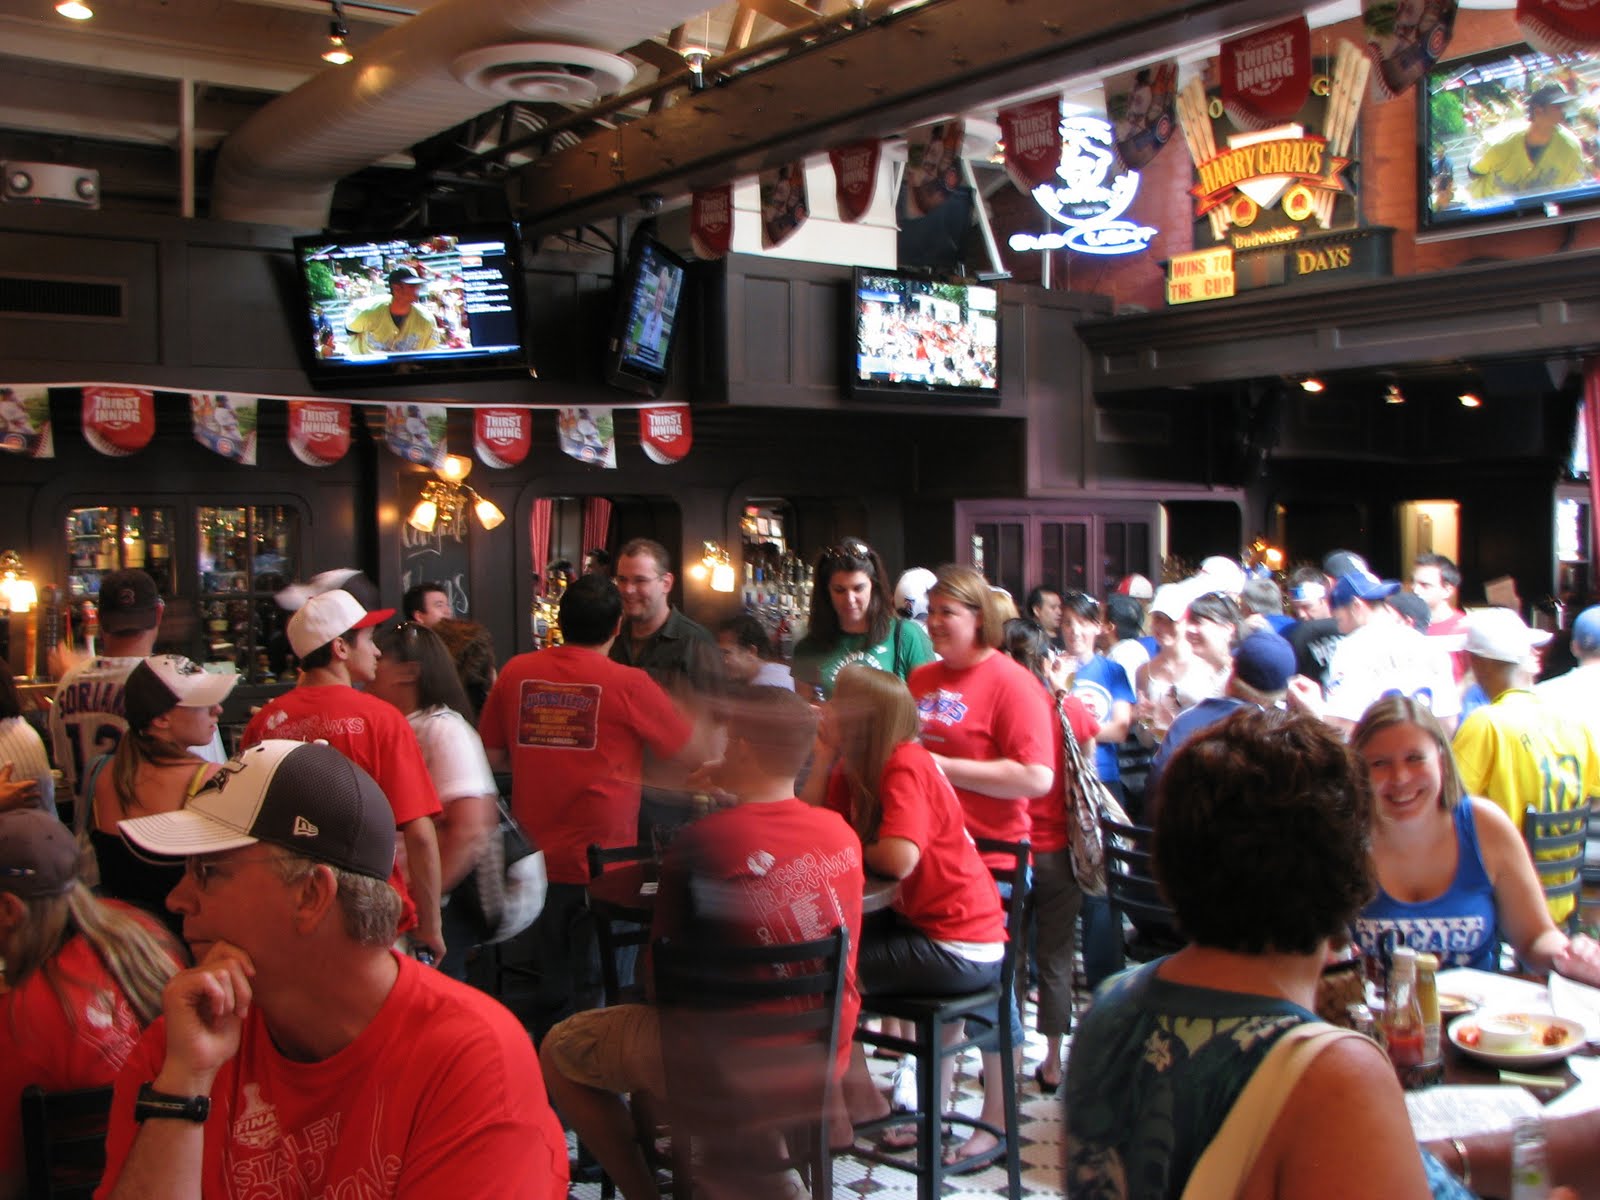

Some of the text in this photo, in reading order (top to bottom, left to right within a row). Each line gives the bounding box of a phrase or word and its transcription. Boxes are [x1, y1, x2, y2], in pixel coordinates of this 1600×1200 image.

[1234, 35, 1294, 71] THIRST
[1237, 57, 1295, 91] INNING
[1011, 112, 1052, 139] THIRST
[1015, 132, 1054, 155] INNING
[1199, 148, 1257, 195] HARRY
[1232, 226, 1300, 249] Budweiser
[1173, 255, 1230, 280] WINS TO
[1296, 247, 1351, 275] DAYS
[1170, 276, 1231, 301] THE CUP
[94, 396, 141, 410] THIRST
[95, 408, 141, 423] INNING
[300, 408, 339, 423] THIRST
[483, 415, 522, 428] THIRST
[647, 412, 682, 426] THIRST
[301, 421, 341, 436] INNING
[485, 426, 523, 440] INNING
[650, 424, 683, 438] INNING
[1357, 928, 1484, 954] CHCAGO
